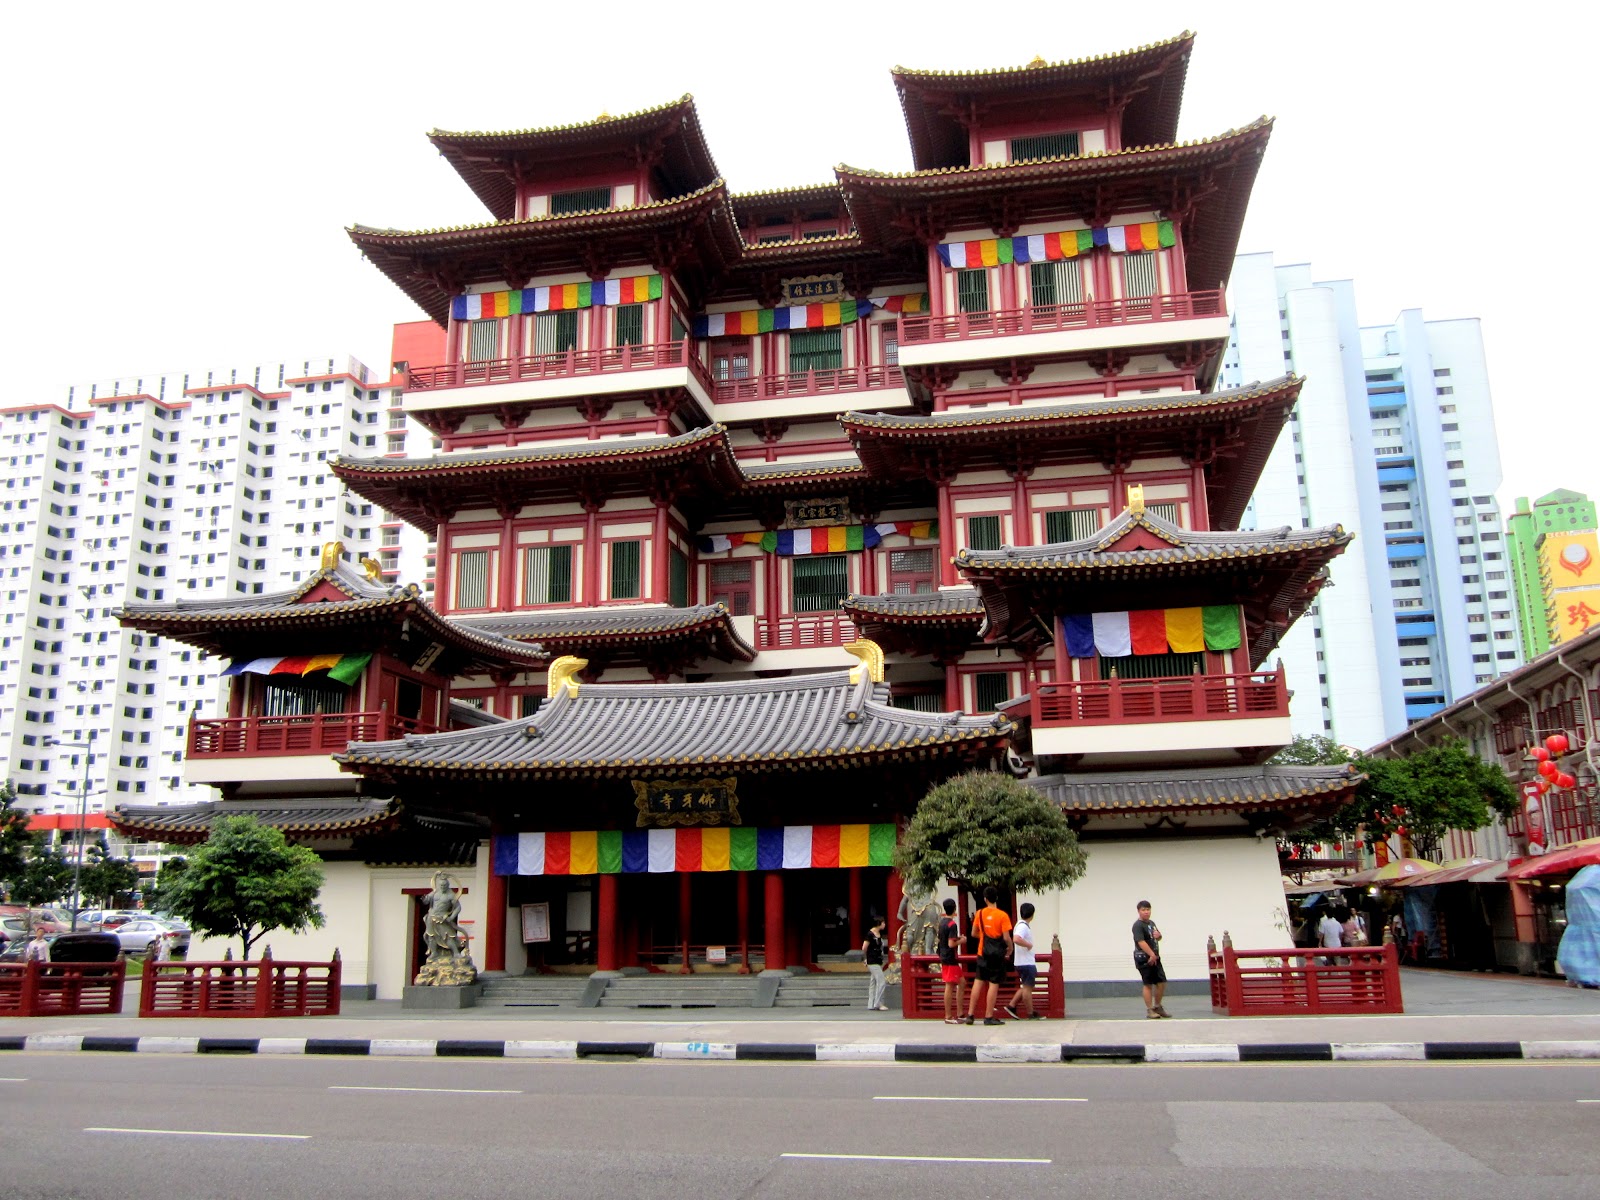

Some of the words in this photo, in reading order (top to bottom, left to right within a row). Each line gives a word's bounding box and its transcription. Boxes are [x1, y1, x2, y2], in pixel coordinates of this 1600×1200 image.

[1566, 601, 1600, 632] 珍
[659, 793, 716, 810] 佛牙寺
